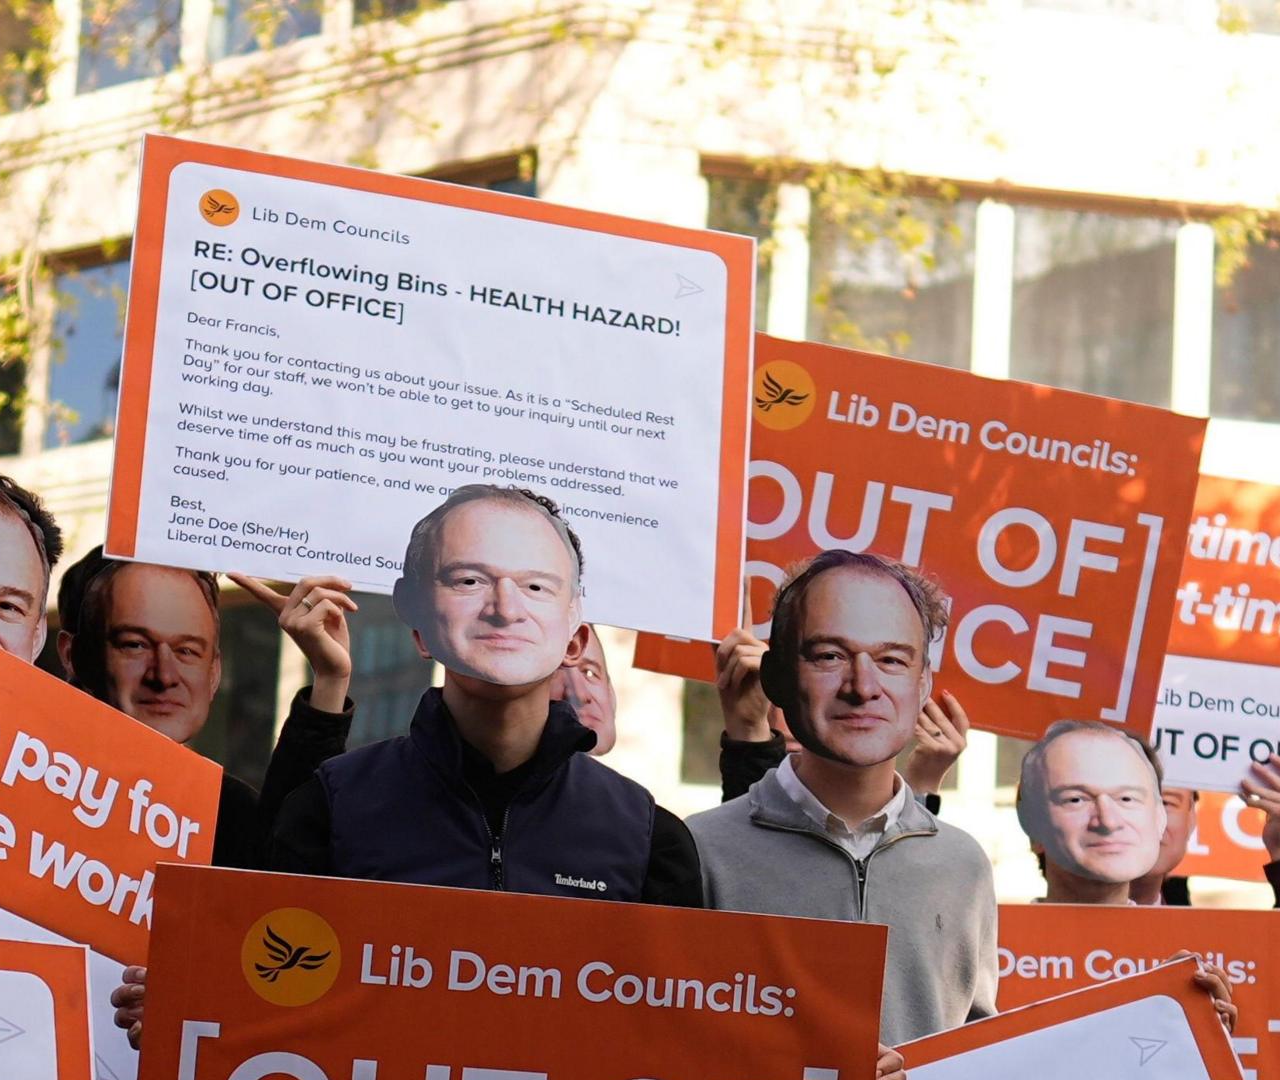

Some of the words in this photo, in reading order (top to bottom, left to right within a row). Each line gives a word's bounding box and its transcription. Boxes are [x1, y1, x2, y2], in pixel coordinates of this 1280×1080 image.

[251, 205, 280, 225] Lib
[284, 210, 328, 232] Dem
[331, 218, 411, 246] Councils
[189, 268, 257, 298] [OUT
[261, 281, 299, 304] OF
[304, 288, 405, 327] OFFICE]
[193, 238, 234, 263] RE:
[239, 246, 390, 293] Overflowing
[396, 271, 449, 298] Bins
[469, 283, 566, 319] HEALTH
[571, 301, 681, 338] HAZARD!
[186, 310, 223, 329] Dear
[224, 317, 281, 340] Francis,
[827, 391, 879, 427] Lib
[888, 402, 969, 444] Dem
[980, 421, 1138, 476] Councils:
[169, 494, 207, 514] Best,
[167, 511, 205, 529] Jane
[207, 516, 240, 533] Doe
[240, 520, 310, 545] (She/Her)
[1188, 691, 1234, 713] Dem
[1193, 732, 1240, 761] OF
[1, 731, 119, 829] pay
[128, 779, 199, 859] for
[29, 831, 155, 930] work
[554, 873, 596, 890] Timberland
[361, 943, 432, 990] Lib
[448, 950, 561, 999] Dem
[577, 960, 795, 1019] Councils:
